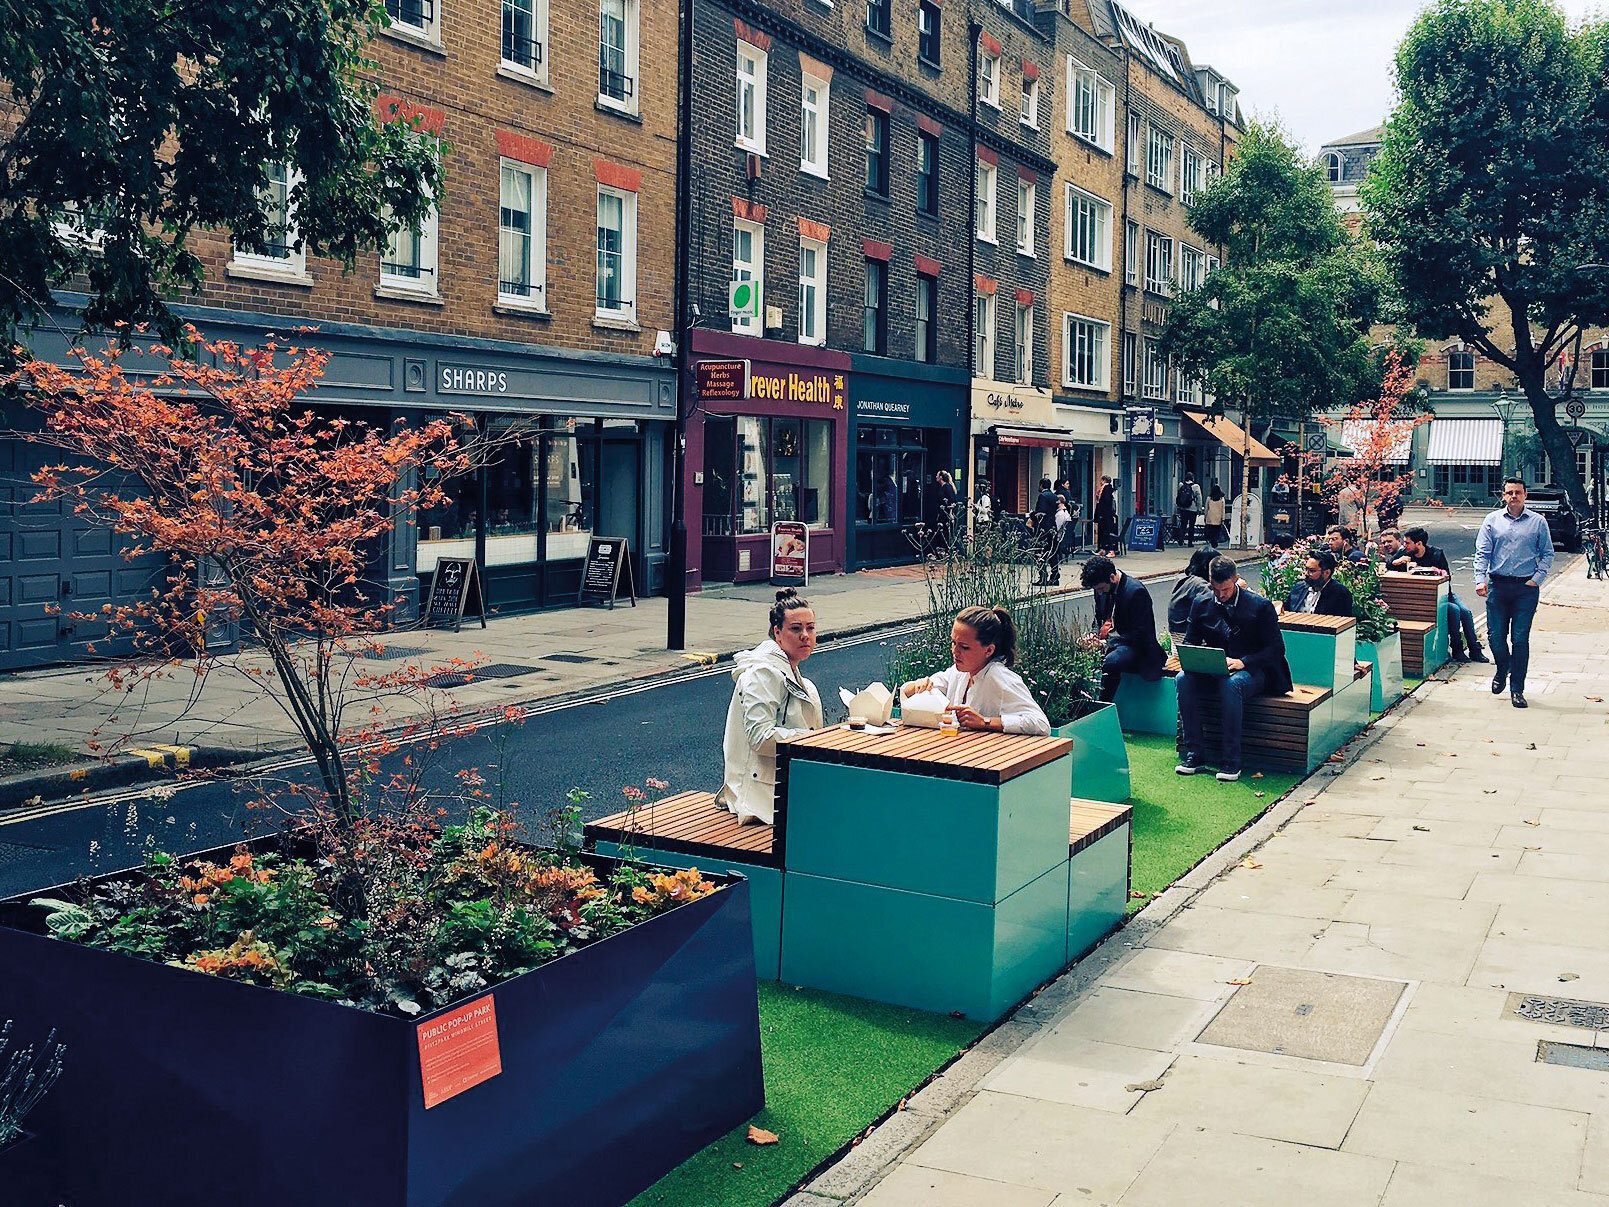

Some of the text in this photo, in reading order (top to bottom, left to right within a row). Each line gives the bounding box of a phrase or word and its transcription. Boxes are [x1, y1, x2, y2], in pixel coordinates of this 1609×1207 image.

[701, 363, 742, 371] Acupuncture
[442, 367, 508, 393] SHARPS
[706, 380, 735, 388] Massage
[751, 373, 830, 402] rever Health
[701, 389, 740, 397] Reflexology
[857, 400, 884, 411] JONATHAN
[1568, 404, 1583, 413] 30
[422, 1004, 491, 1040] PUBLIC POP-UP PARK
